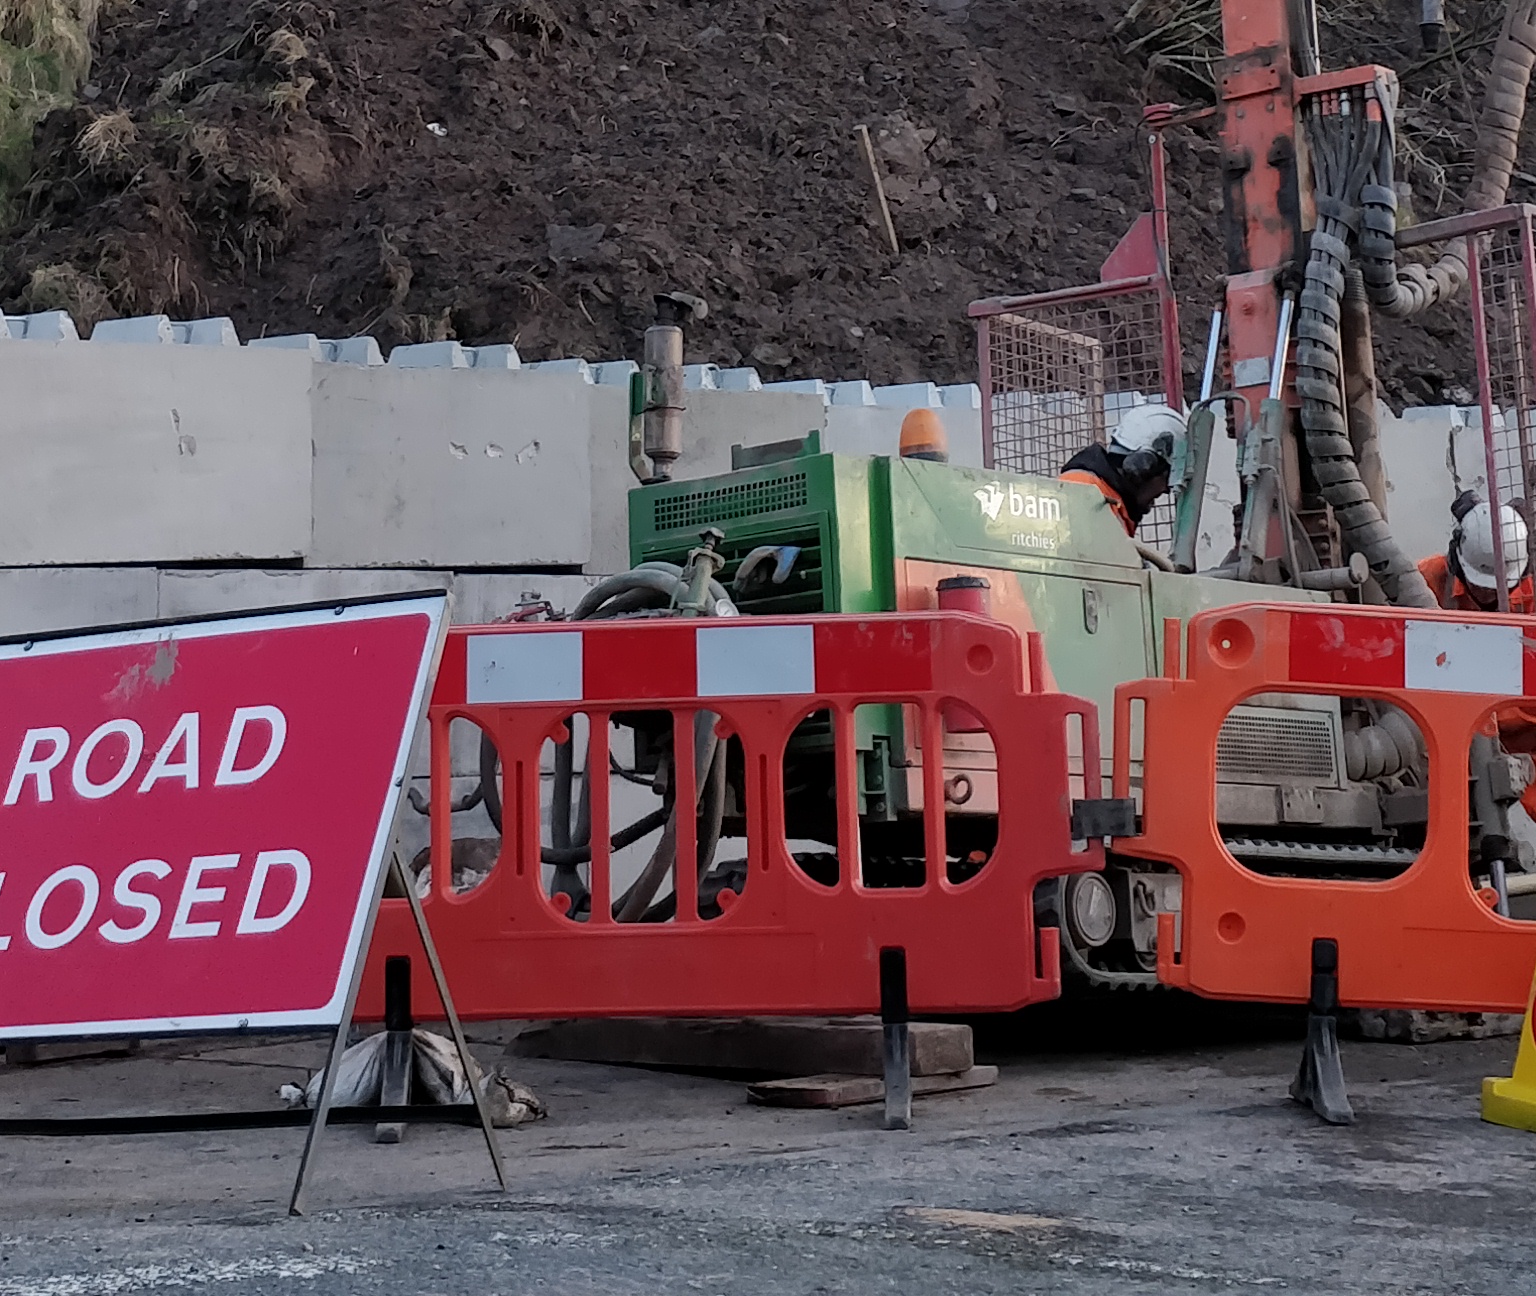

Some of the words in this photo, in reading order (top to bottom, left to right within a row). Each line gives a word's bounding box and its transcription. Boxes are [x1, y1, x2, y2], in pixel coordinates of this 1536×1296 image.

[1009, 483, 1061, 522] bam
[1011, 531, 1056, 550] ritchies
[3, 705, 287, 806] ROAD
